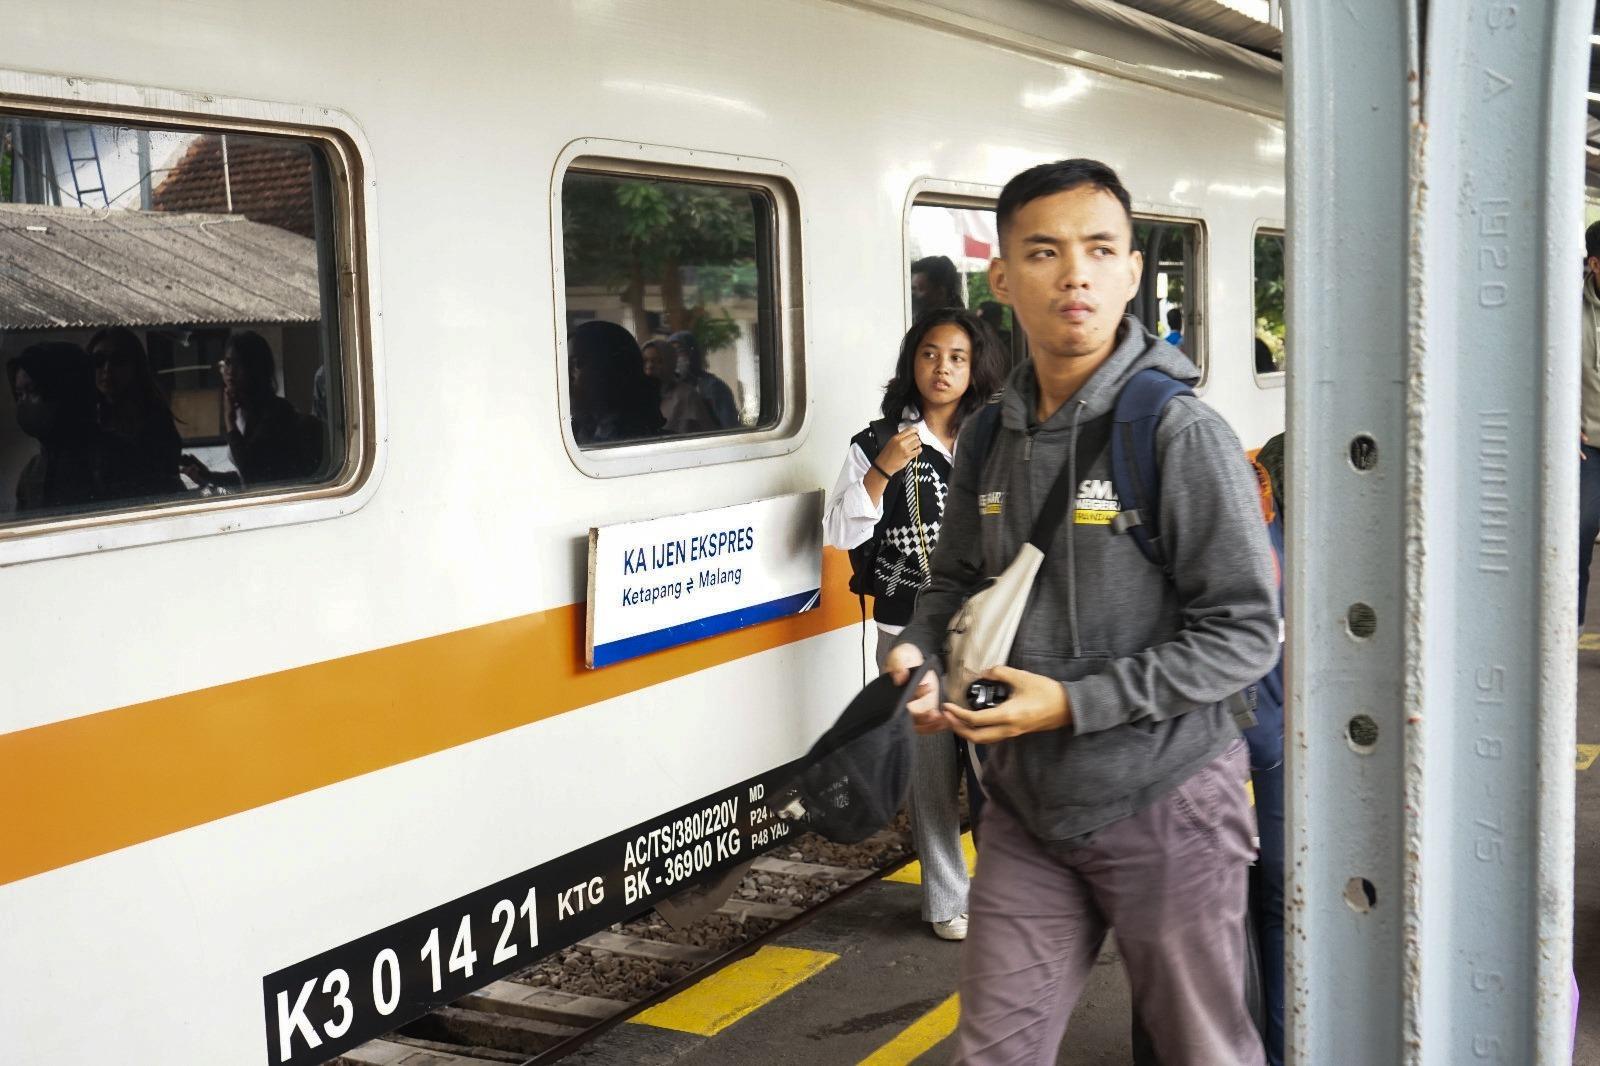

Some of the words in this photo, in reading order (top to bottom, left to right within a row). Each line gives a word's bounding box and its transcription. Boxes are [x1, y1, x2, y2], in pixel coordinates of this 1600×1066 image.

[1077, 479, 1119, 500] SM
[623, 547, 647, 576] KA
[652, 539, 686, 570] IJEN
[691, 526, 754, 562] EKSPRES
[622, 581, 682, 607] Ketapang
[699, 567, 742, 589] Malang
[749, 784, 764, 803] MD
[623, 796, 739, 871] AC/TS/380/220V
[750, 805, 767, 827] P24
[751, 828, 769, 850] P48
[624, 869, 652, 906] BK
[717, 828, 741, 862] KG
[276, 968, 354, 1063] K3
[372, 947, 401, 1016] 0
[420, 914, 478, 993] 14
[491, 886, 539, 966] 21
[557, 875, 605, 921] KTG
